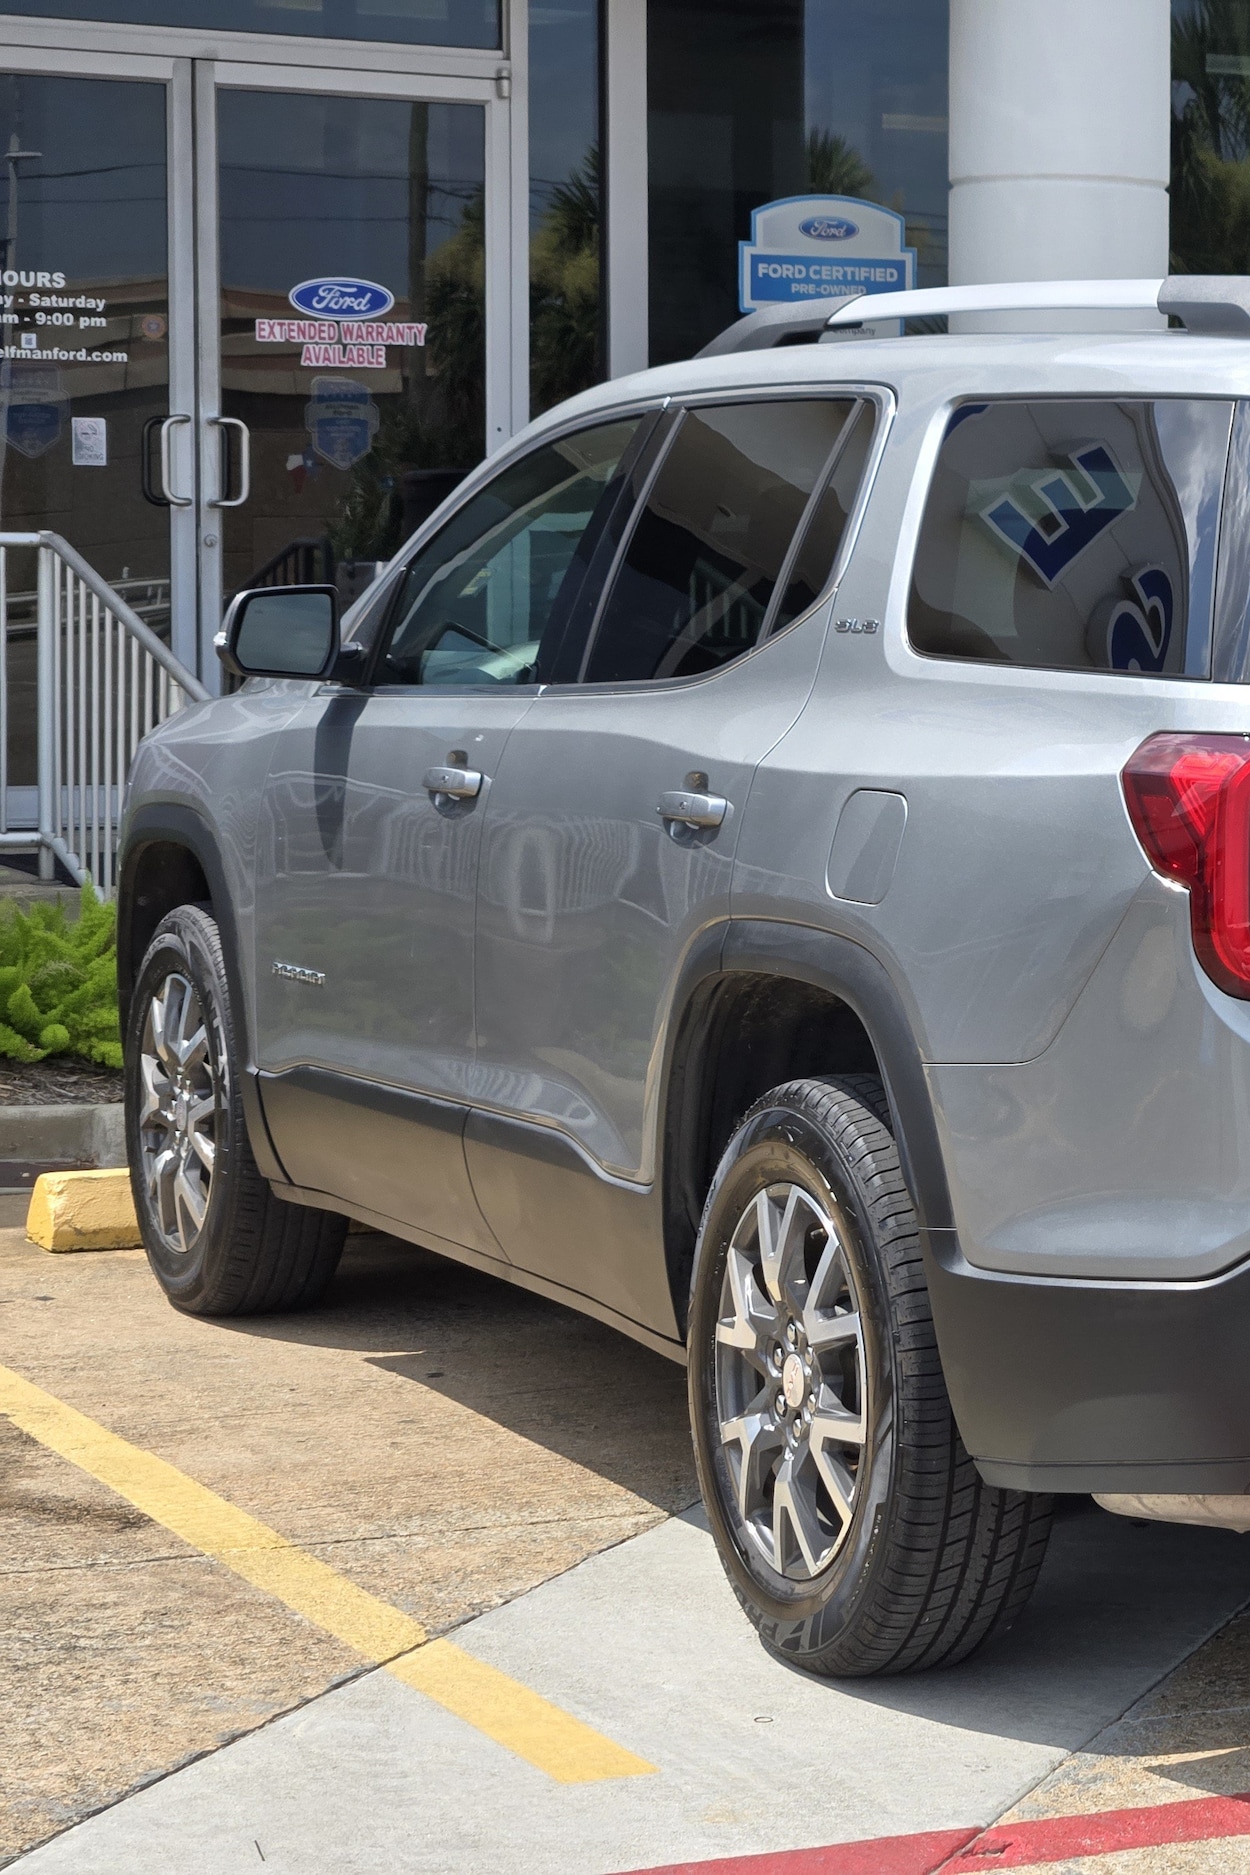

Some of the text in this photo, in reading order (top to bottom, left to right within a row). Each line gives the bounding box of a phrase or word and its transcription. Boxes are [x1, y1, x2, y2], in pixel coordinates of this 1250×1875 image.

[810, 219, 848, 237] Ford
[0, 268, 66, 289] OURS
[757, 262, 899, 283] FORD CERTIFIED
[311, 284, 373, 312] Ford
[790, 282, 867, 296] PRE-OWNED
[29, 292, 106, 312] Saturday
[34, 311, 75, 326] 9:00
[79, 316, 107, 329] pm
[256, 320, 427, 345] EXTENDED WARRANTY
[302, 345, 386, 367] AVAILABLE
